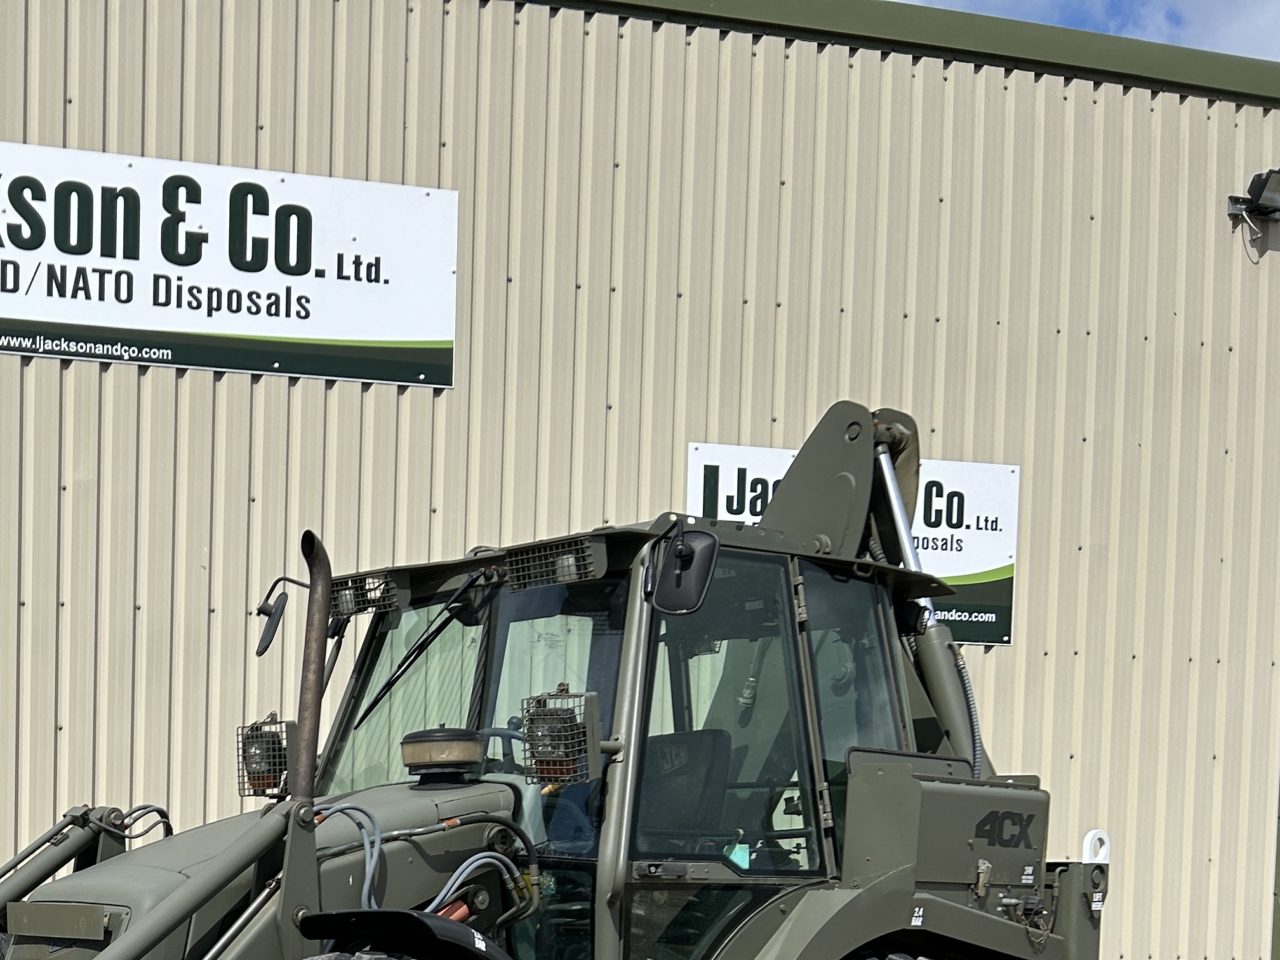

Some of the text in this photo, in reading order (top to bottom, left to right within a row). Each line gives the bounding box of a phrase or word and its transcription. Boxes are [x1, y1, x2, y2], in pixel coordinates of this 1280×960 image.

[161, 175, 209, 267] &
[229, 183, 326, 279] Co.
[336, 252, 390, 285] Ltd.
[152, 273, 311, 320] Disposals
[923, 480, 971, 530] Co.
[975, 515, 1003, 532] Ltd.
[974, 810, 1036, 850] 4CX
